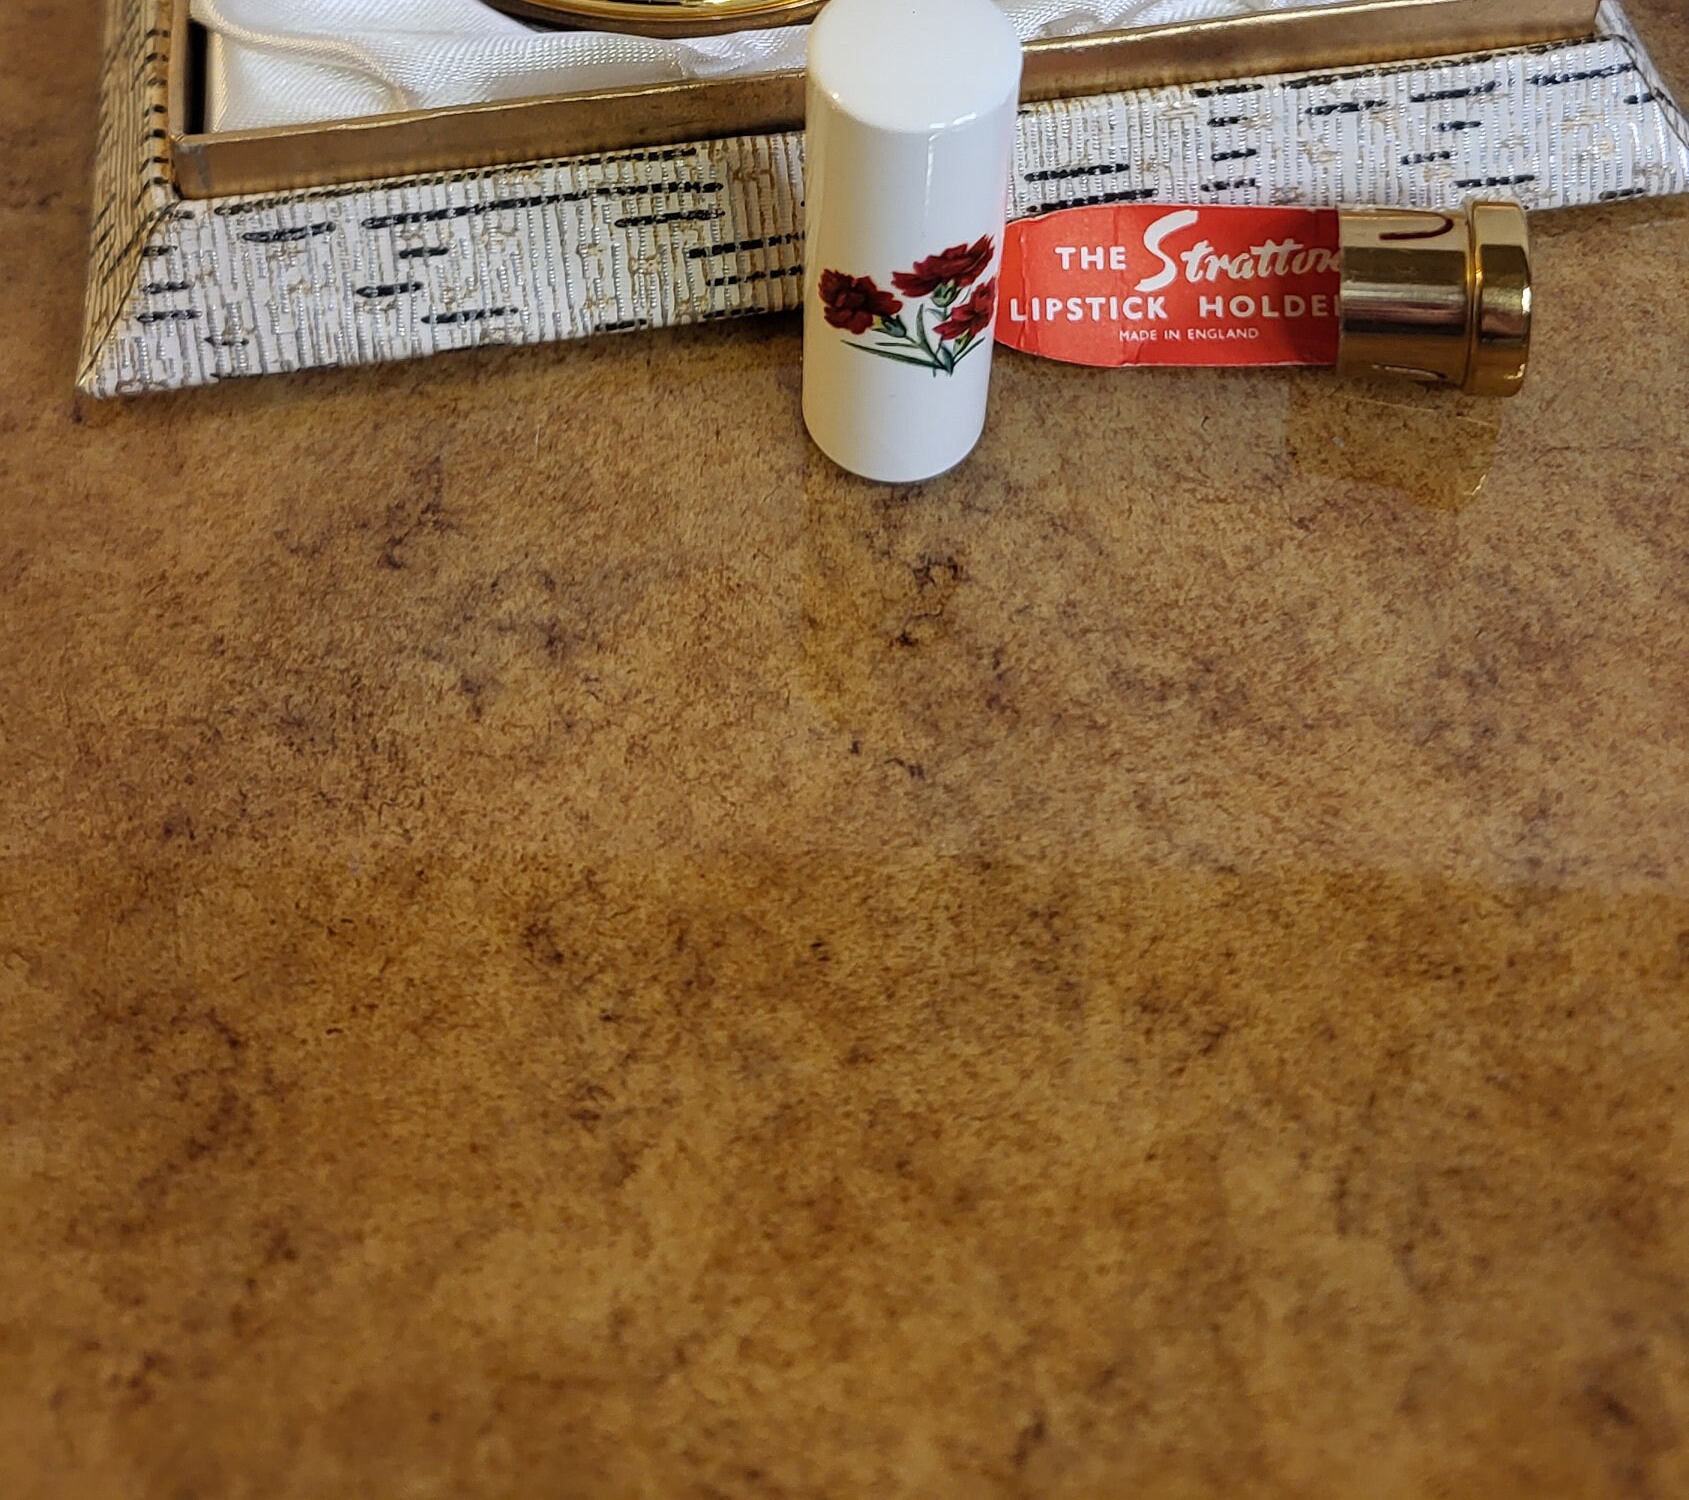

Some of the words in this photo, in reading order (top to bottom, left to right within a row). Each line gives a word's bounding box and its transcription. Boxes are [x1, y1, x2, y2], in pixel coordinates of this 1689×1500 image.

[1055, 245, 1127, 272] THE
[1133, 208, 1340, 292] Stratton
[1009, 295, 1168, 322] LIPSTICK
[1119, 329, 1158, 342] MADE
[1164, 329, 1181, 341] IN
[1187, 327, 1260, 341] ENGLAND
